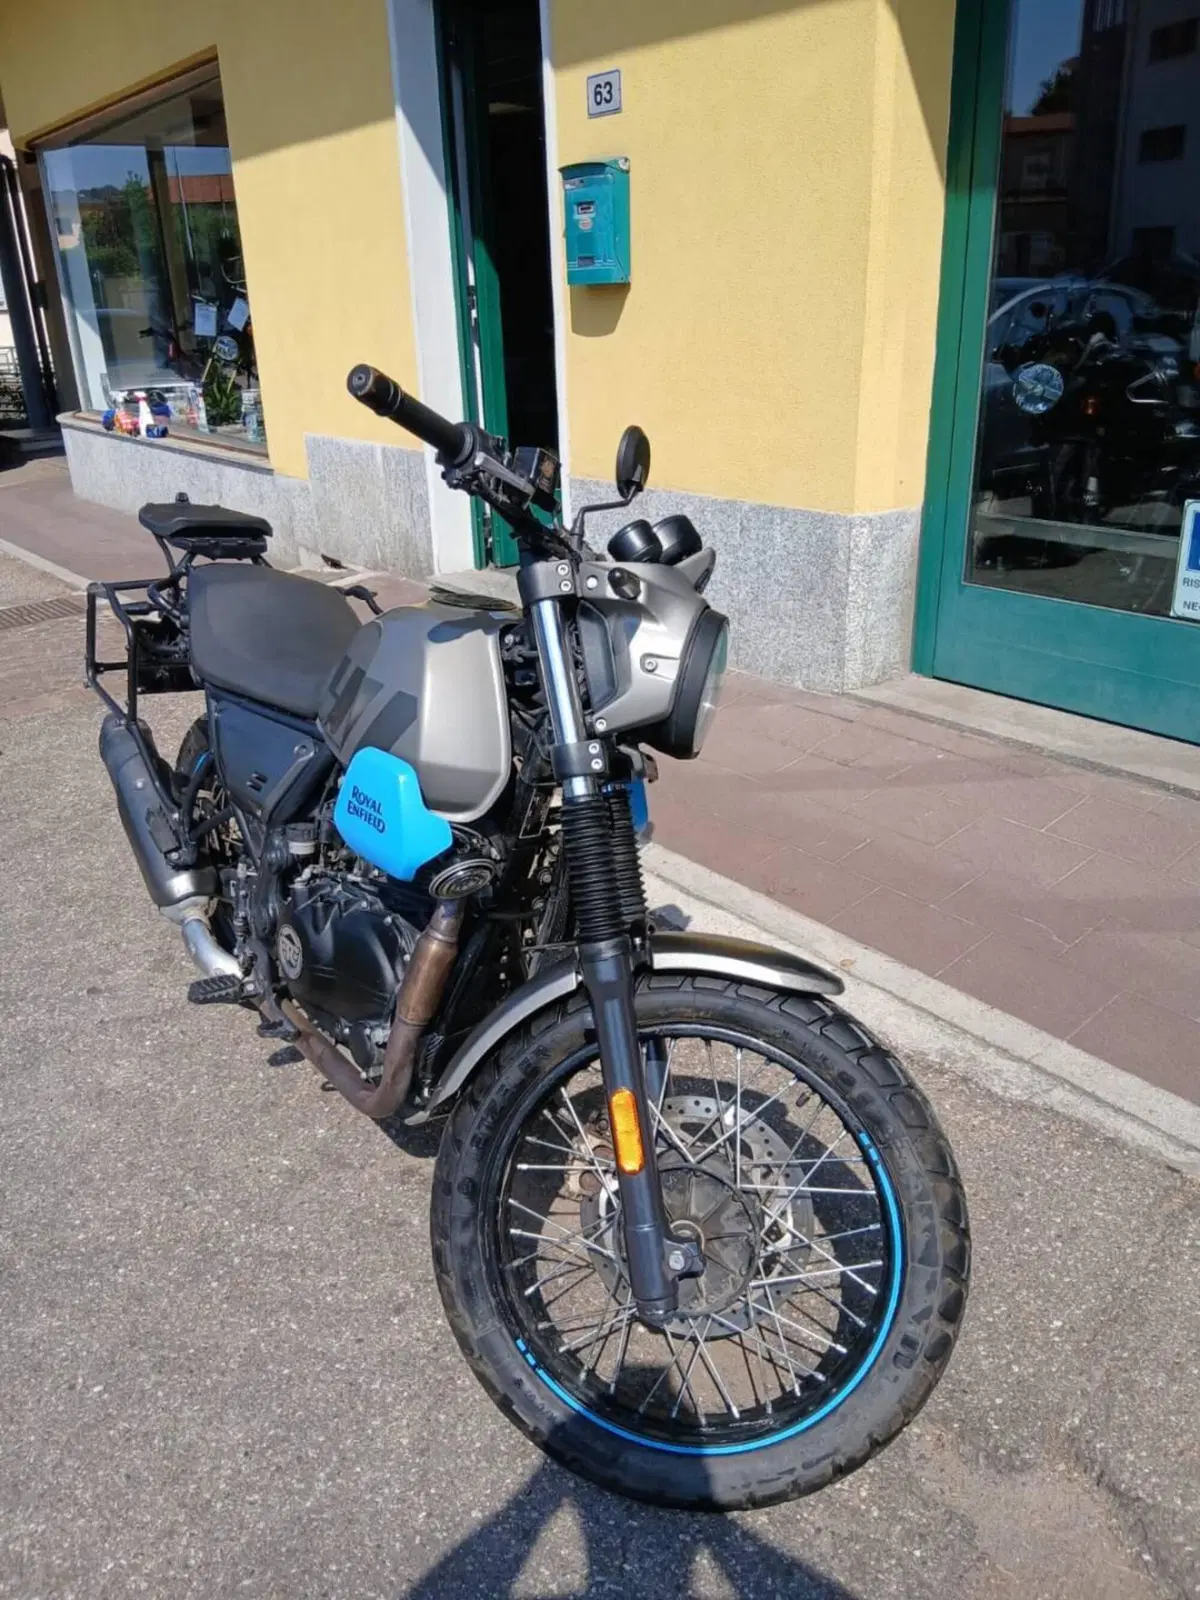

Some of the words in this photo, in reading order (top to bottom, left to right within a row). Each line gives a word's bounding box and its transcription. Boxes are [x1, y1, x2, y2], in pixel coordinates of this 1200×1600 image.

[594, 81, 613, 106] 63
[1183, 600, 1200, 612] NE
[352, 785, 382, 816] ROYAL
[348, 800, 385, 833] ENFIELD
